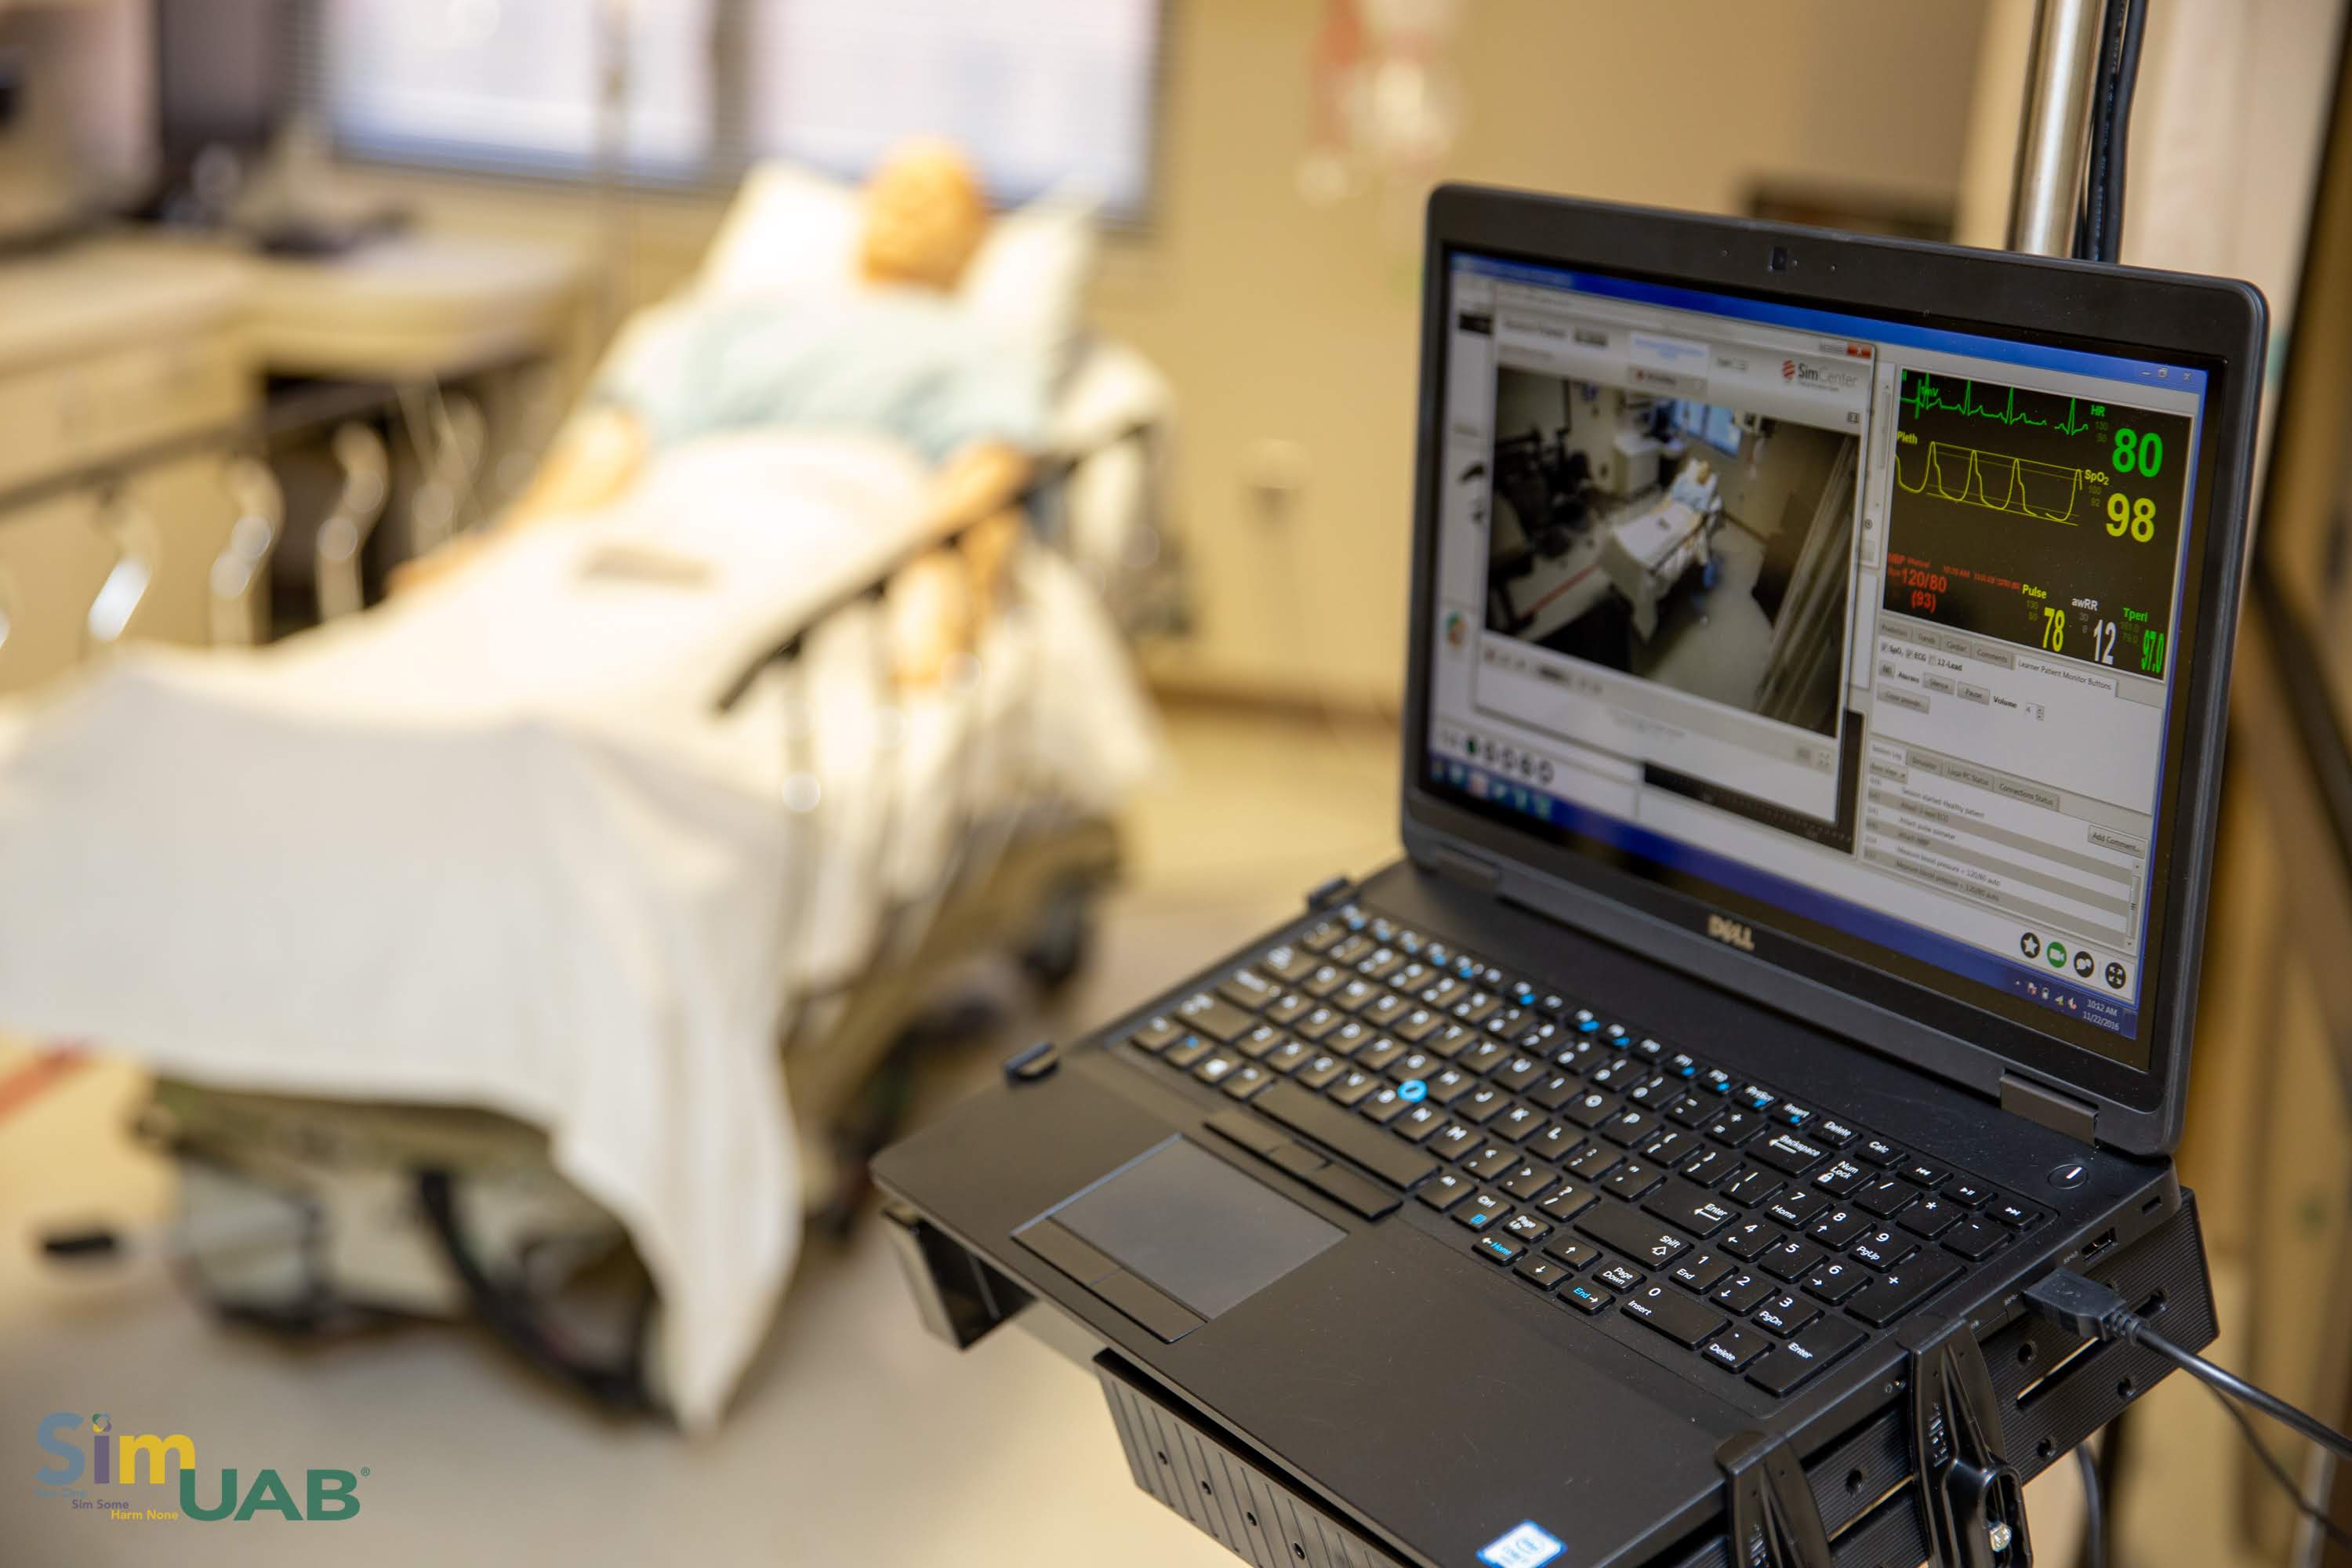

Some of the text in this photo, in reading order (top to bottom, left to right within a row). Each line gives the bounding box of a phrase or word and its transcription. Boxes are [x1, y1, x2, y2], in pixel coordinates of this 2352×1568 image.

[1798, 363, 1858, 387] SimCenter
[2090, 405, 2106, 417] HR
[1897, 430, 1918, 445] Pleth
[2112, 428, 2164, 477] 80
[2106, 492, 2156, 543] 98
[1901, 568, 1947, 593] 120/80
[2022, 584, 2047, 599] Pulse
[1911, 590, 1936, 613] (93)
[2071, 597, 2098, 612] awRR
[2122, 607, 2148, 622] Tperi
[2042, 607, 2066, 652] 78
[2093, 619, 2116, 665] 12
[2141, 630, 2165, 673] 97.0
[1914, 652, 1926, 662] ECG
[1937, 659, 1963, 671] 12-Lead
[2018, 660, 2112, 690] Learner Patient Monitor Buttons
[1994, 695, 2018, 709] Volume
[1999, 783, 2053, 806] Connections Status
[2092, 832, 2105, 842] Add
[1708, 914, 1755, 951] DELL
[2105, 1006, 2118, 1017] AM
[1824, 1120, 1852, 1137] Delete
[1779, 1134, 1820, 1157] Backspace
[1869, 1141, 1890, 1153] Calc
[1830, 1167, 1852, 1180] Lock
[1838, 1160, 1859, 1174] Num
[1791, 1192, 1806, 1200] 7
[1704, 1203, 1728, 1217] Enter
[1771, 1204, 1797, 1220] Home
[1833, 1212, 1846, 1221] 8
[1744, 1224, 1759, 1232] 4
[1659, 1235, 1682, 1248] Shift
[1875, 1232, 1889, 1242] 9
[1785, 1243, 1800, 1253] 5
[1857, 1245, 1880, 1260] PgUp
[1698, 1255, 1709, 1265] 1
[1613, 1266, 1634, 1279] Page
[1676, 1268, 1695, 1280] End
[1828, 1265, 1842, 1275] 6
[1602, 1271, 1625, 1285] Down
[1736, 1276, 1751, 1287] 2
[1573, 1287, 1592, 1299] End
[1648, 1287, 1661, 1297] 0
[1628, 1300, 1652, 1316] Insert
[1779, 1297, 1795, 1308] 3
[1759, 1310, 1784, 1327] PgDn
[1709, 1343, 1737, 1362] Delete
[1788, 1342, 1813, 1359] Enter
